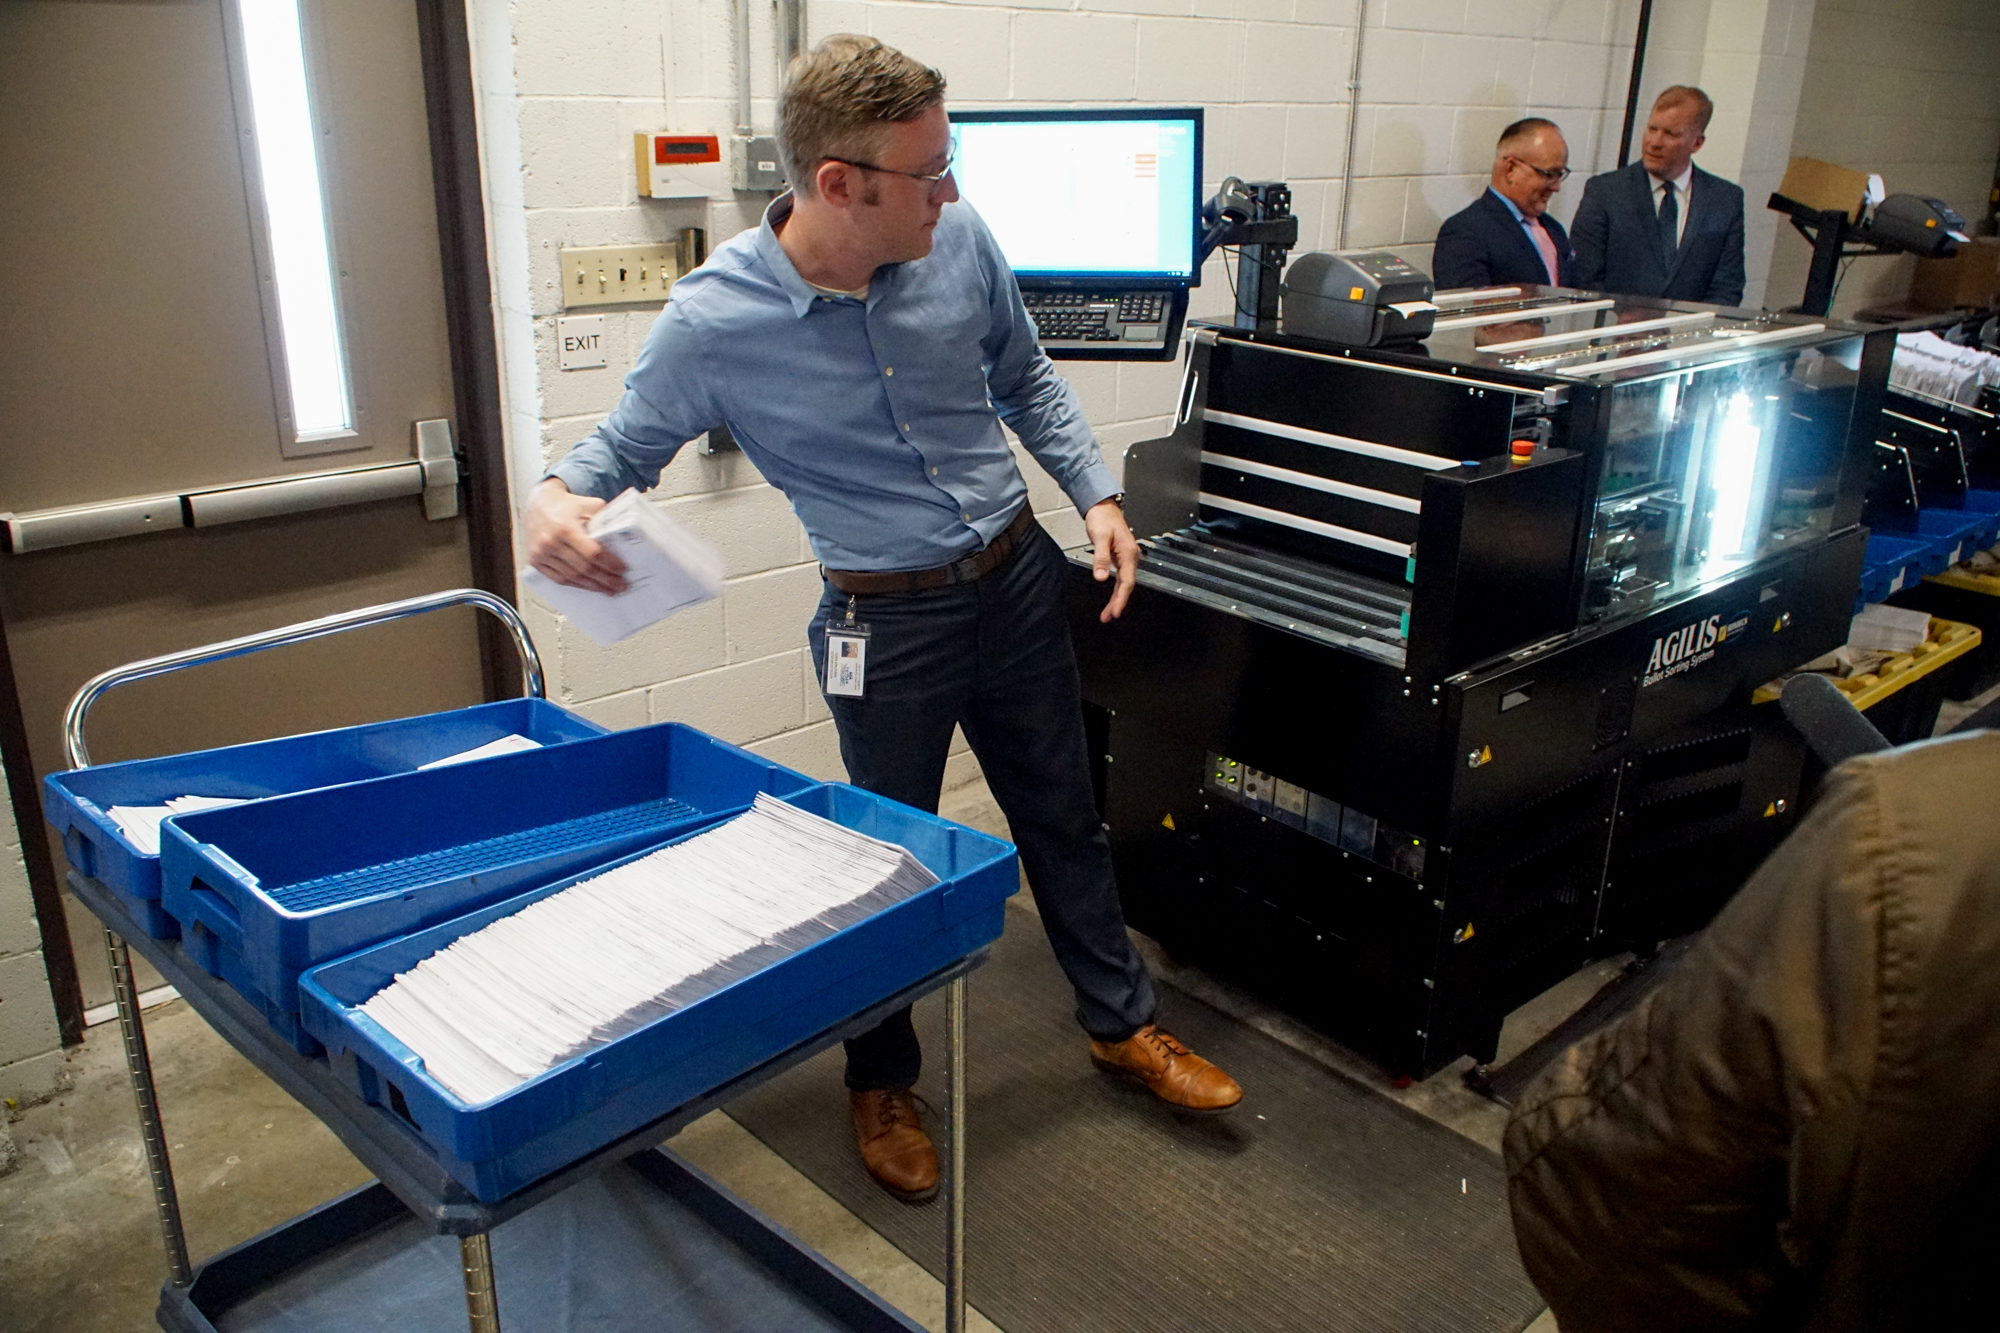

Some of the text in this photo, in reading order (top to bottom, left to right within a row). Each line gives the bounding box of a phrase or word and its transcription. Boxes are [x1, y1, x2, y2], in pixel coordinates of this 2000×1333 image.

[565, 334, 600, 351] EXIT
[1645, 614, 1721, 675] AGILIS
[1643, 650, 1715, 687] Ballot Sorting System
